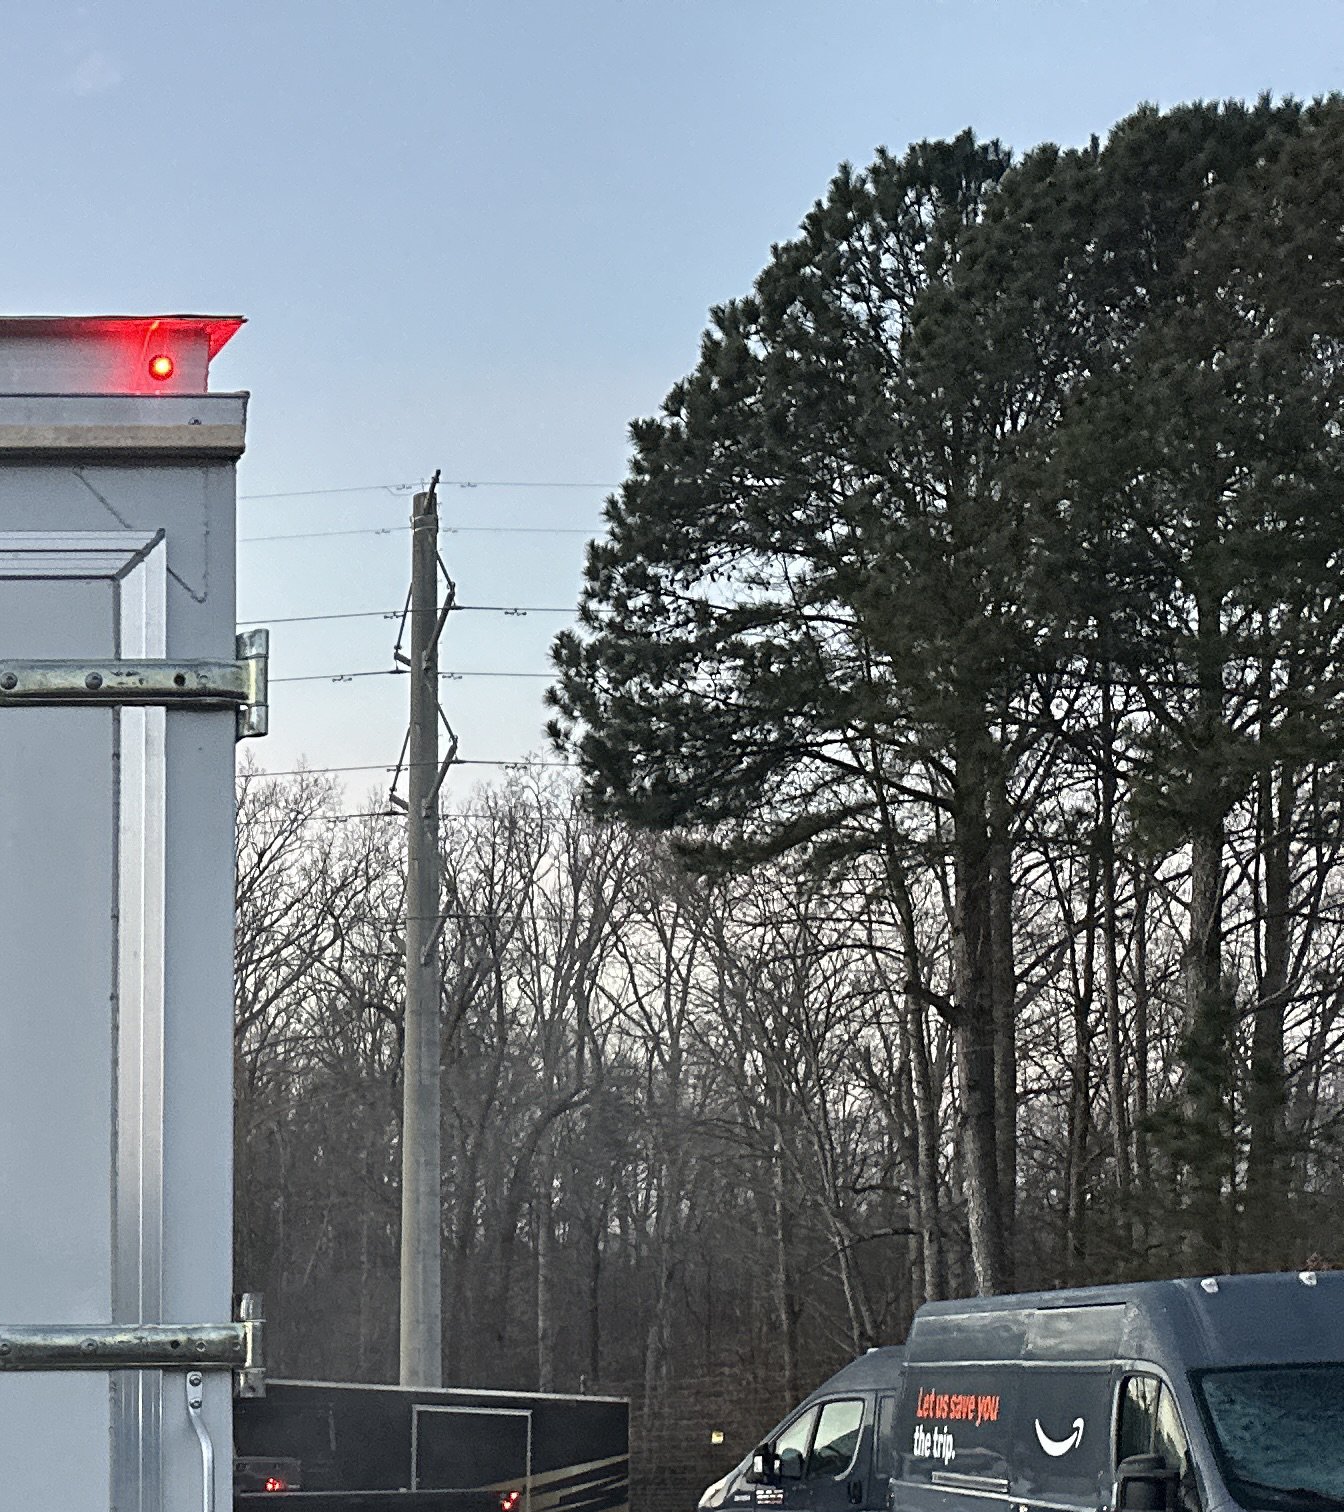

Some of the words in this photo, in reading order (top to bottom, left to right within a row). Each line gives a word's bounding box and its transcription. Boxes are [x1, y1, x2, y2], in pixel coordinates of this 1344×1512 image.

[916, 1386, 935, 1419] Let
[936, 1394, 949, 1419] us
[950, 1394, 975, 1420] save
[975, 1395, 1000, 1427] you
[913, 1424, 932, 1457] the
[933, 1425, 956, 1466] trip.
